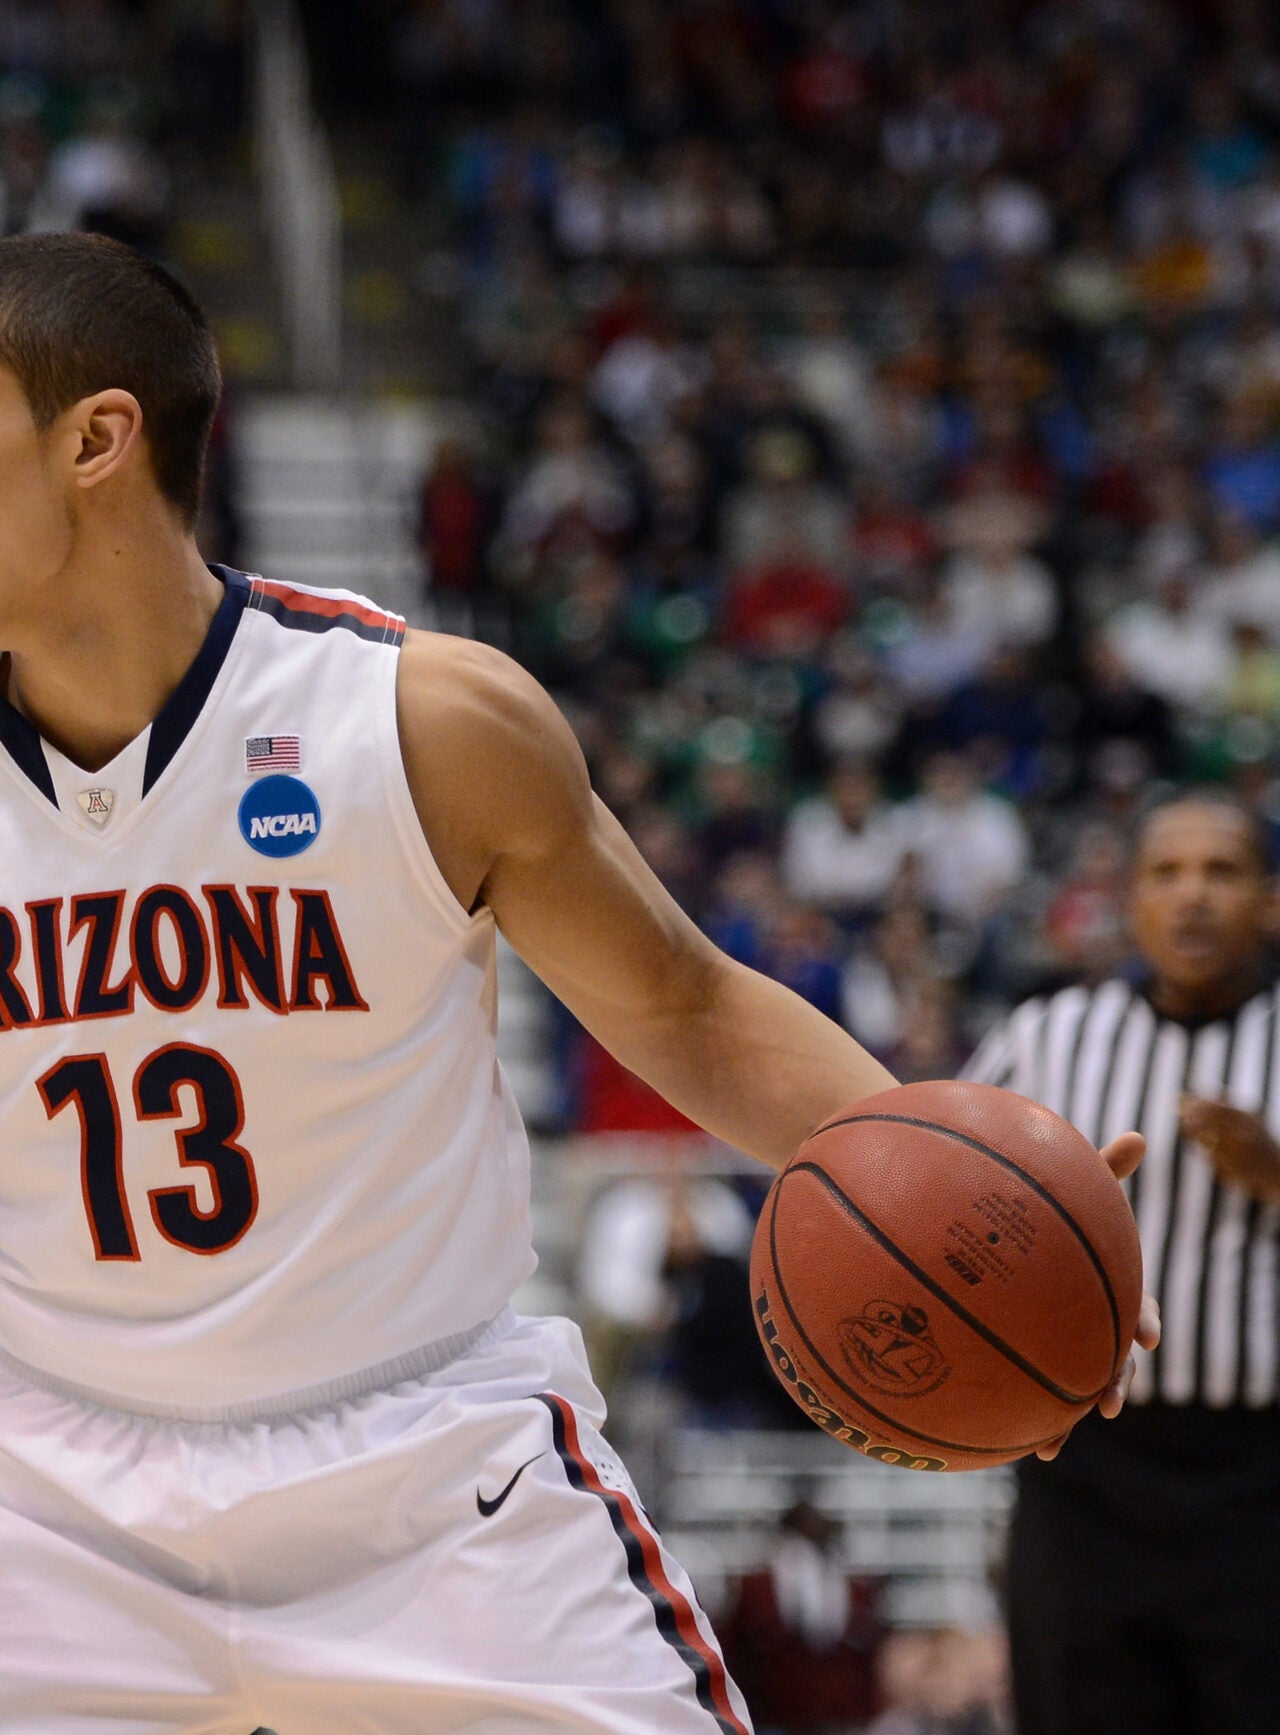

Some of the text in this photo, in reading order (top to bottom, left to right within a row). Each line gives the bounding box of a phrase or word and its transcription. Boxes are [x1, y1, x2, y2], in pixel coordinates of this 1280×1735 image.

[88, 792, 108, 813] A
[250, 812, 317, 839] NCAA
[35, 1041, 259, 1262] 13
